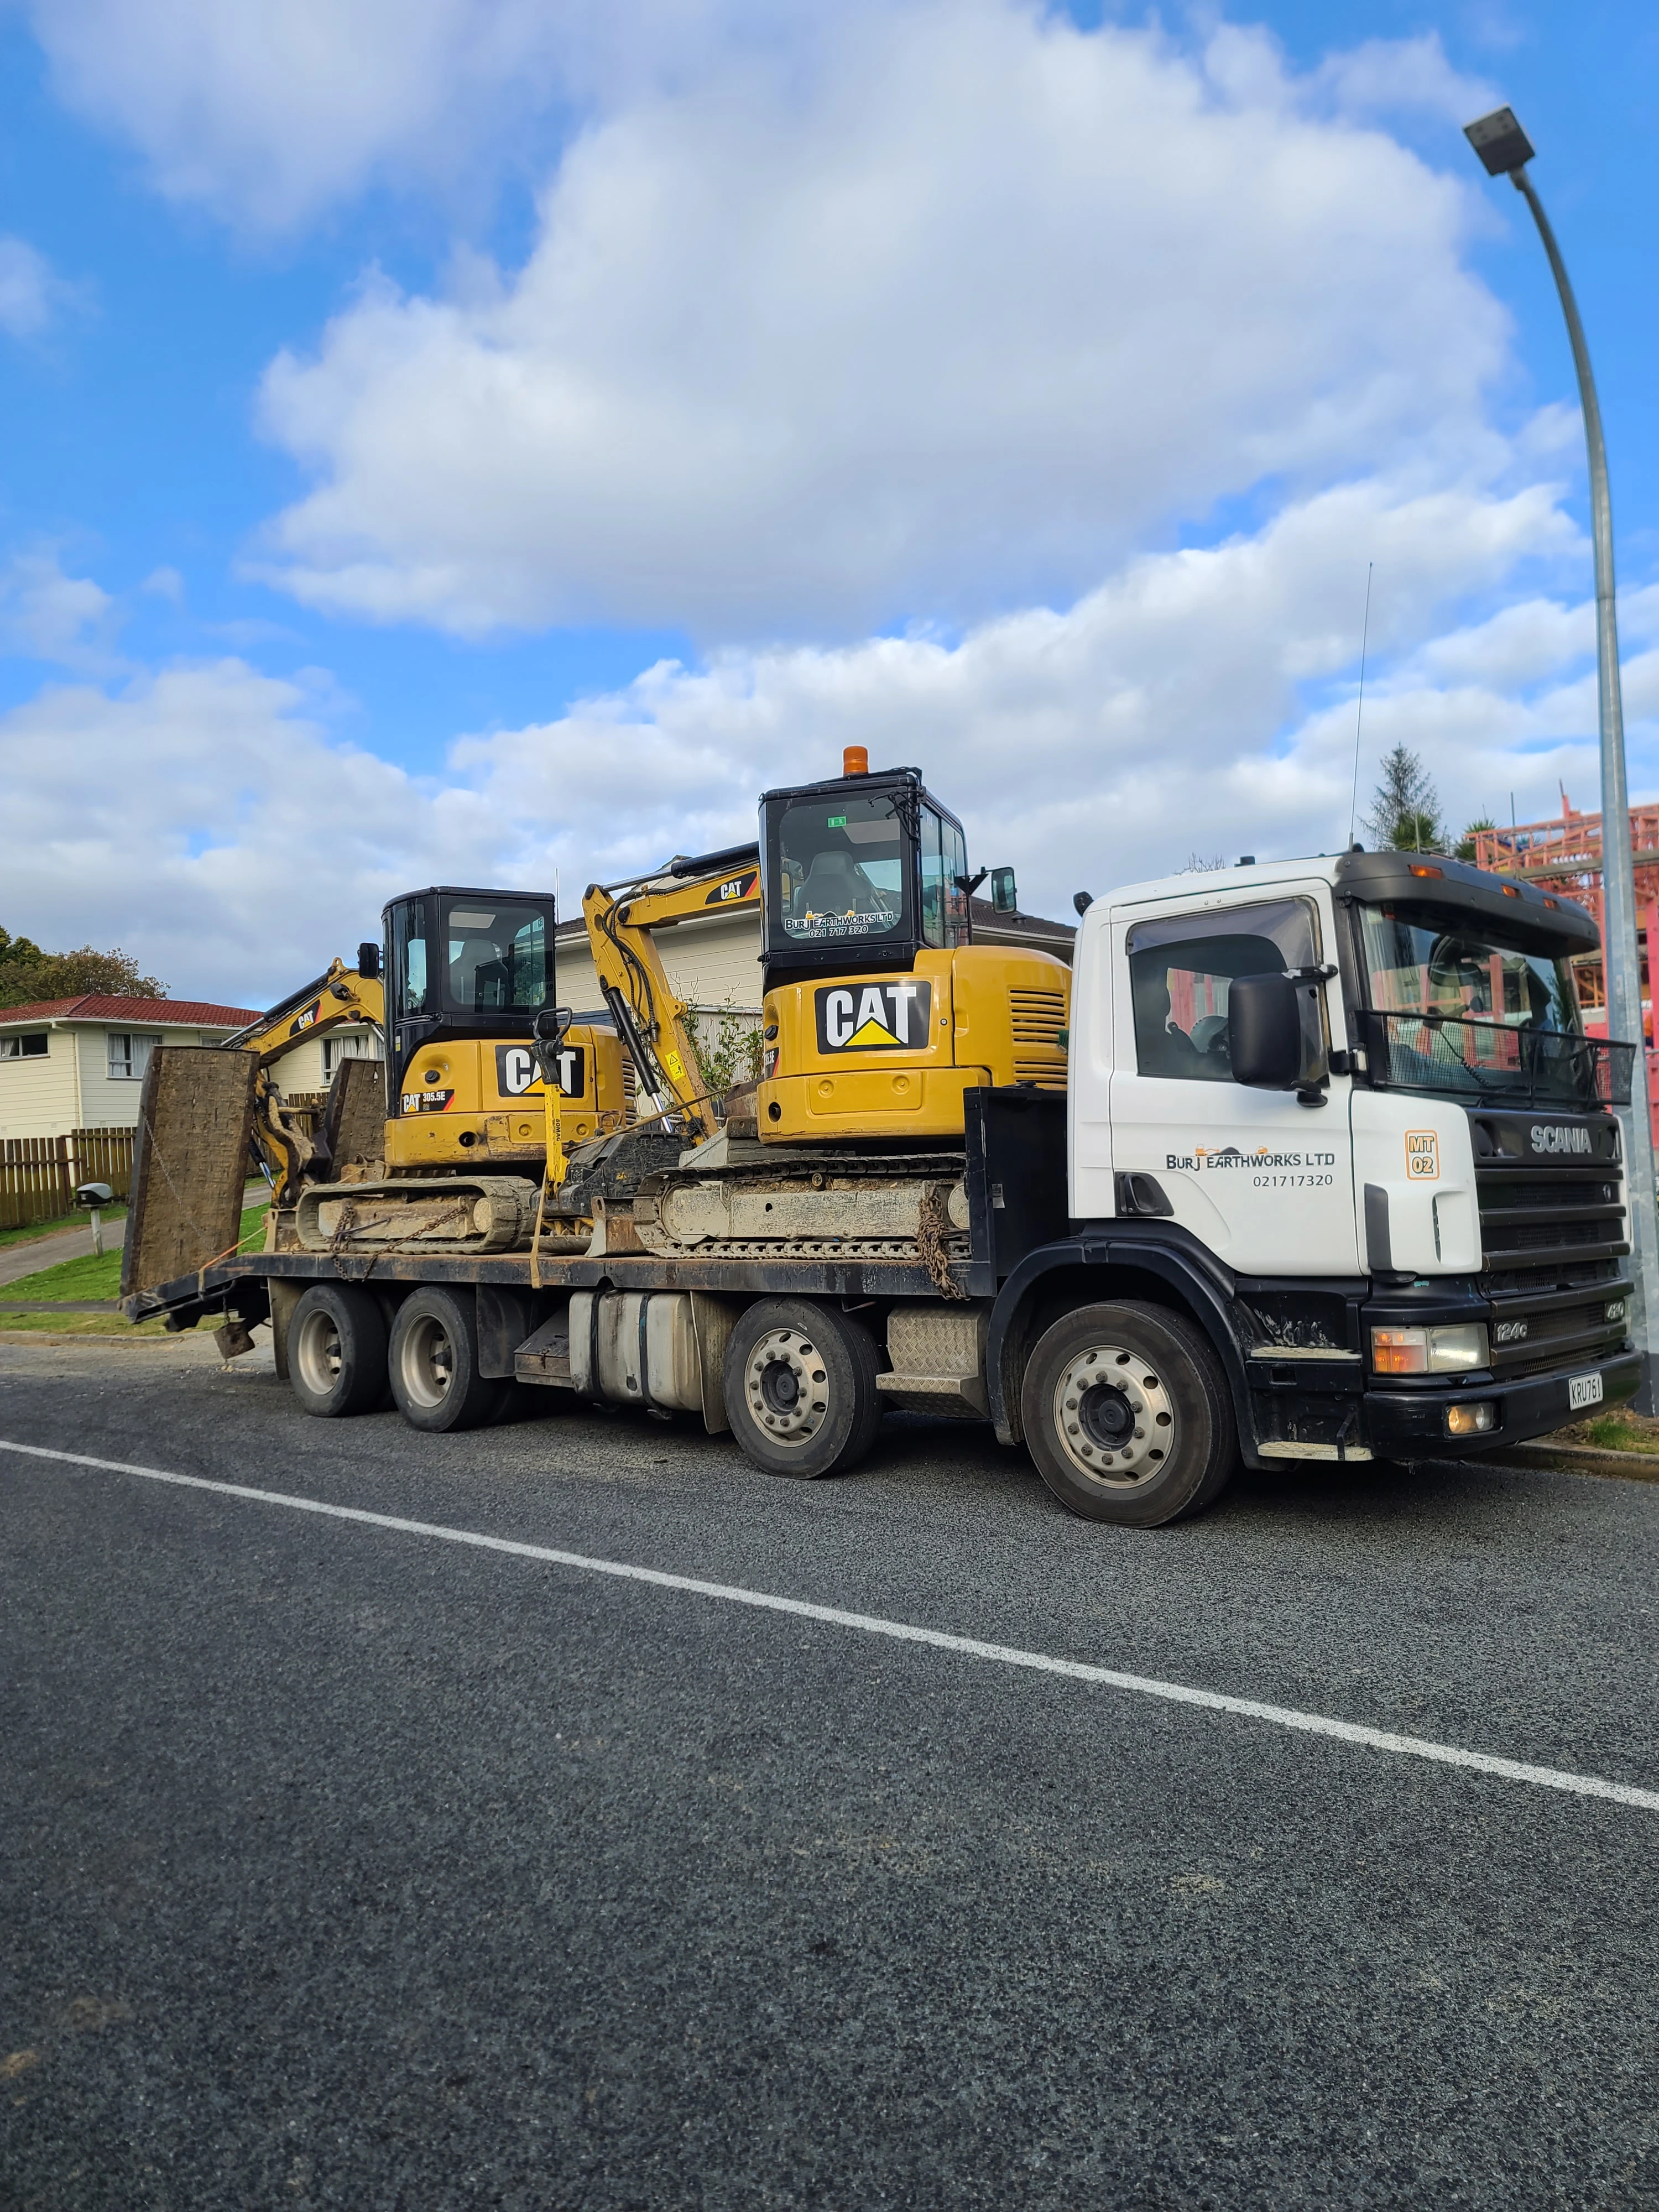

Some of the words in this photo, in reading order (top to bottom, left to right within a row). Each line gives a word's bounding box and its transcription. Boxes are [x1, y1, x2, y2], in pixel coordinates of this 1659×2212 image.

[721, 880, 742, 900] CAT
[813, 915, 875, 927] EARTHWORKS
[878, 912, 893, 922] LTD
[809, 929, 827, 938] 021
[829, 927, 847, 936] 717
[848, 926, 869, 935] 320
[298, 1010, 314, 1029] CAT
[826, 987, 917, 1047] CAT
[403, 1093, 421, 1113] CAT
[422, 1091, 446, 1102] 305.5E
[1409, 1136, 1434, 1152] MT
[1531, 1125, 1593, 1153] SCANIA
[1206, 1153, 1301, 1169] EARTHWORKS
[1305, 1153, 1335, 1166] LTD
[1412, 1156, 1434, 1173] 02
[1253, 1174, 1333, 1187] 021717320
[1572, 1378, 1600, 1405] KRU761
